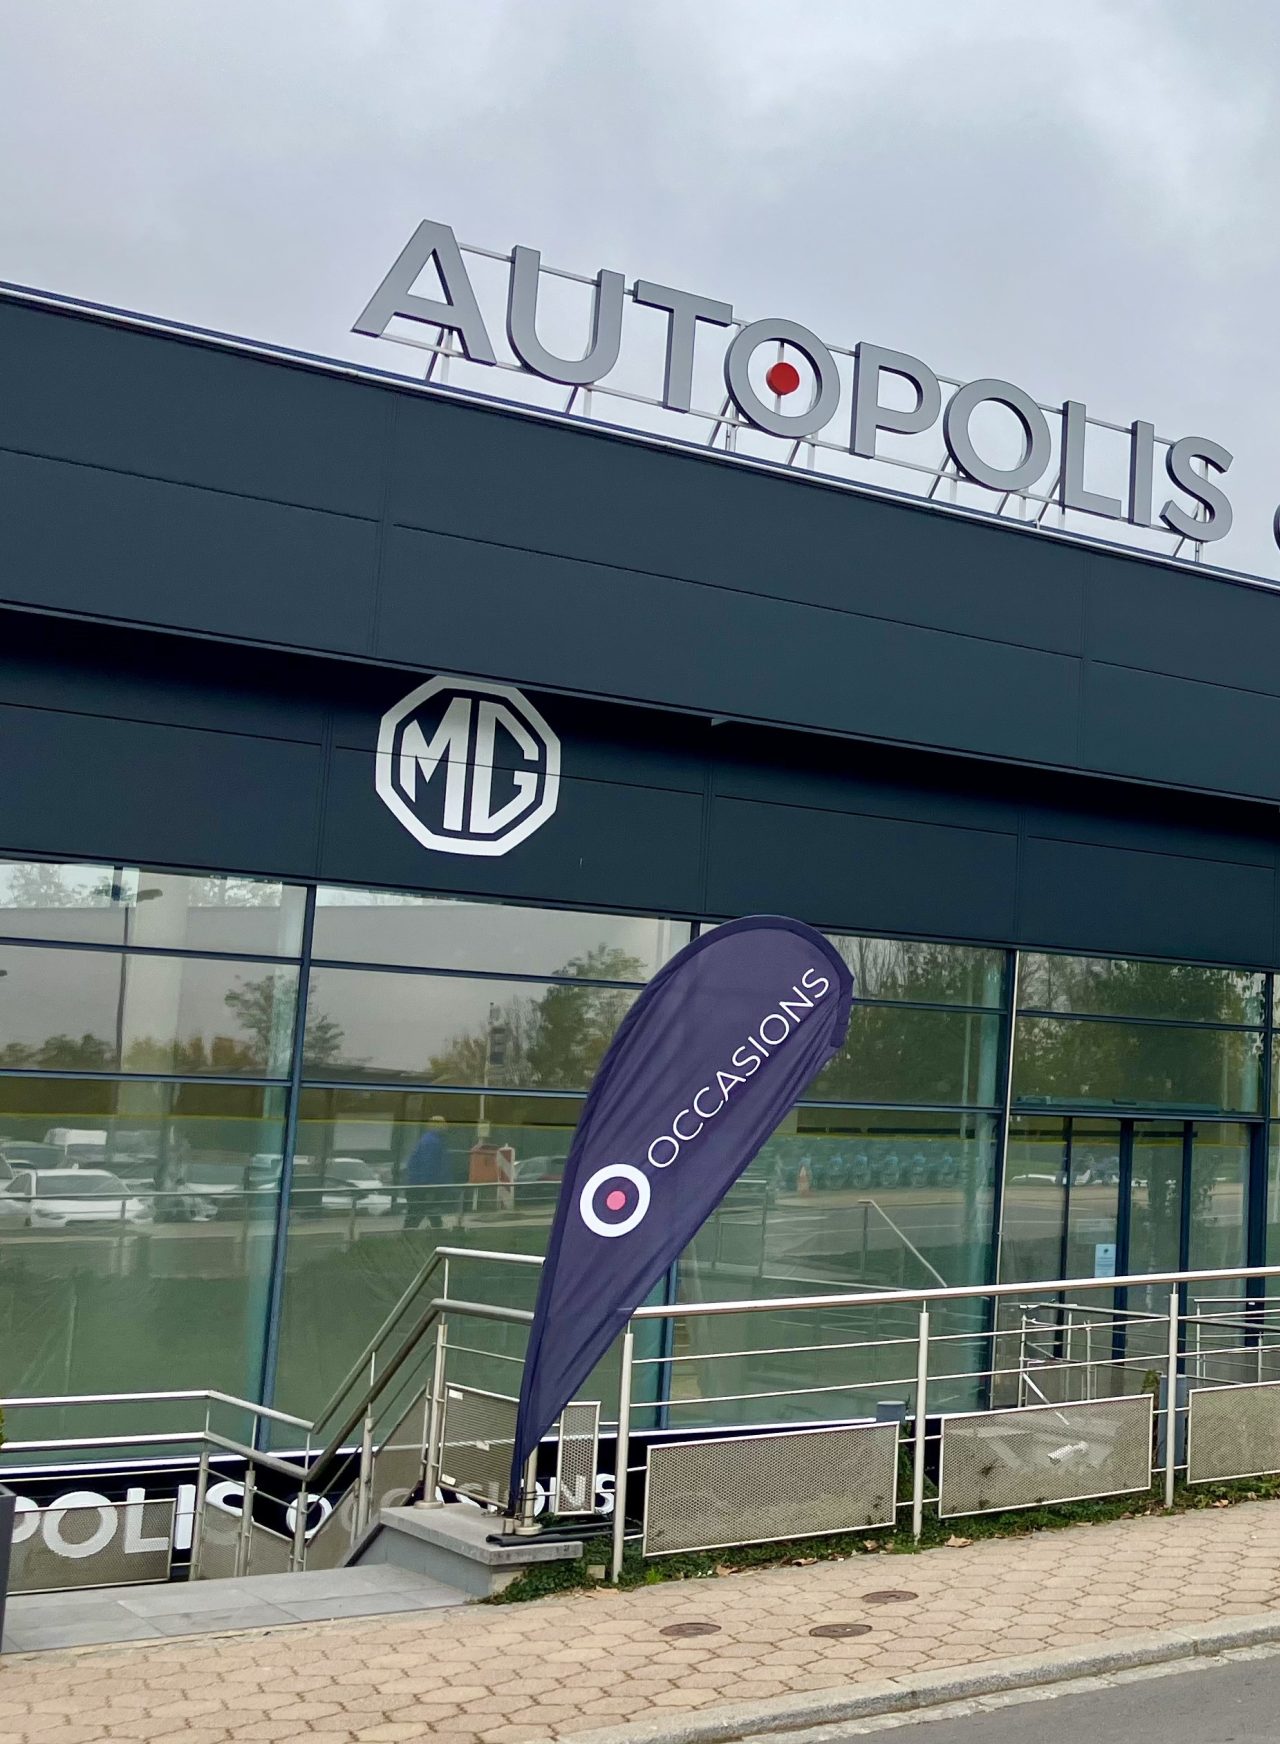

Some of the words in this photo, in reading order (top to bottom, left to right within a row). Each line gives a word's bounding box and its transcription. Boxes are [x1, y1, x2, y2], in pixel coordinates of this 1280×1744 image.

[350, 218, 1235, 543] AUTOPOLIS
[400, 696, 539, 834] MG
[648, 967, 830, 1168] OCCASIONS
